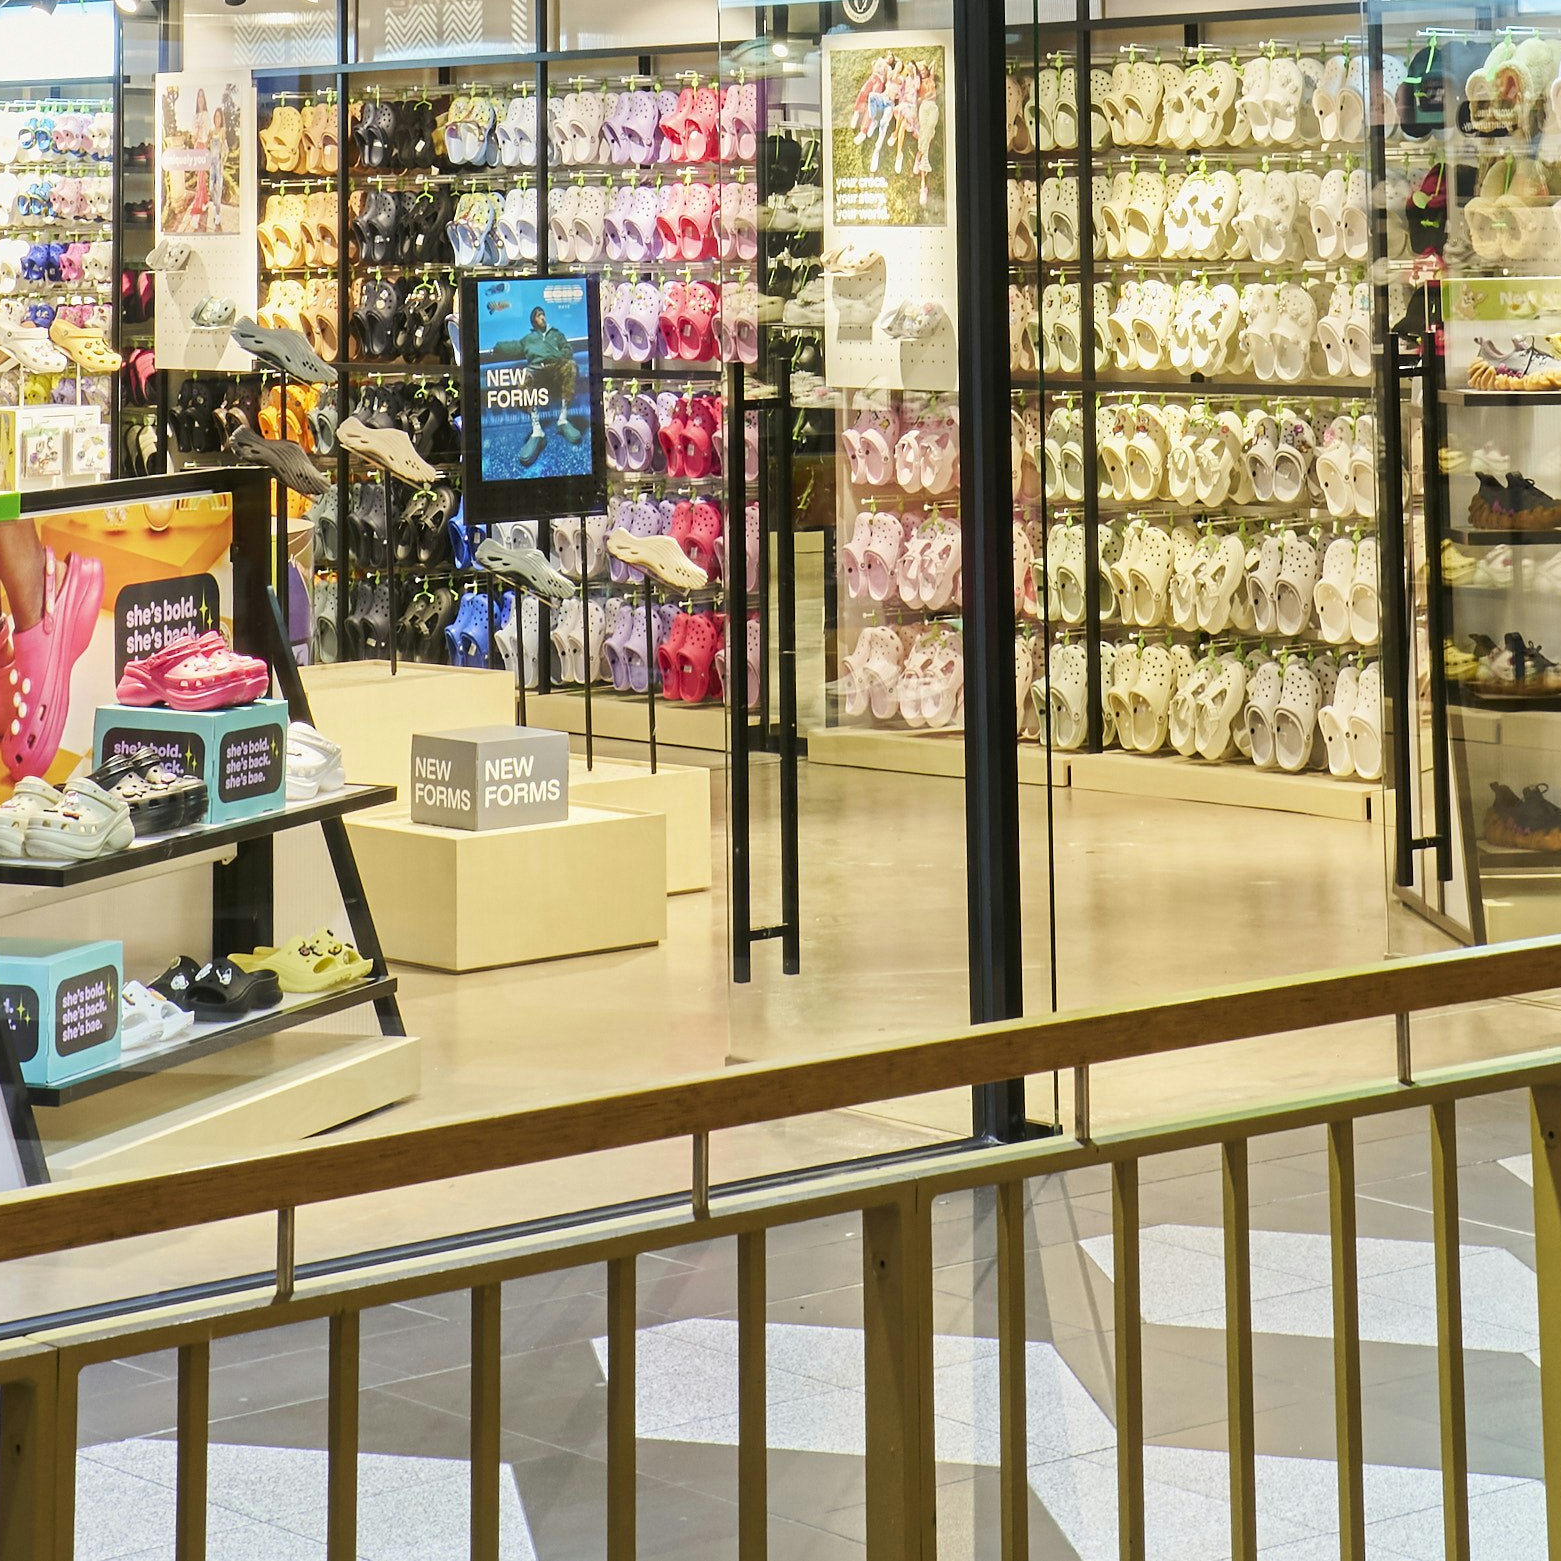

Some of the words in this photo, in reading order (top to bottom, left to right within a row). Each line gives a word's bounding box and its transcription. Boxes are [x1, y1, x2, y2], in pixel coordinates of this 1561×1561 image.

[487, 368, 527, 387] NEW
[487, 388, 549, 408] FORMS
[164, 595, 197, 622] bold.
[249, 737, 269, 752] bold.
[249, 753, 271, 768] back.
[415, 756, 451, 782] NEW
[485, 755, 534, 782] NEW
[415, 782, 471, 811] FORMS
[484, 779, 560, 808] FORMS
[85, 981, 106, 1000] bold.
[85, 998, 107, 1018] back.
